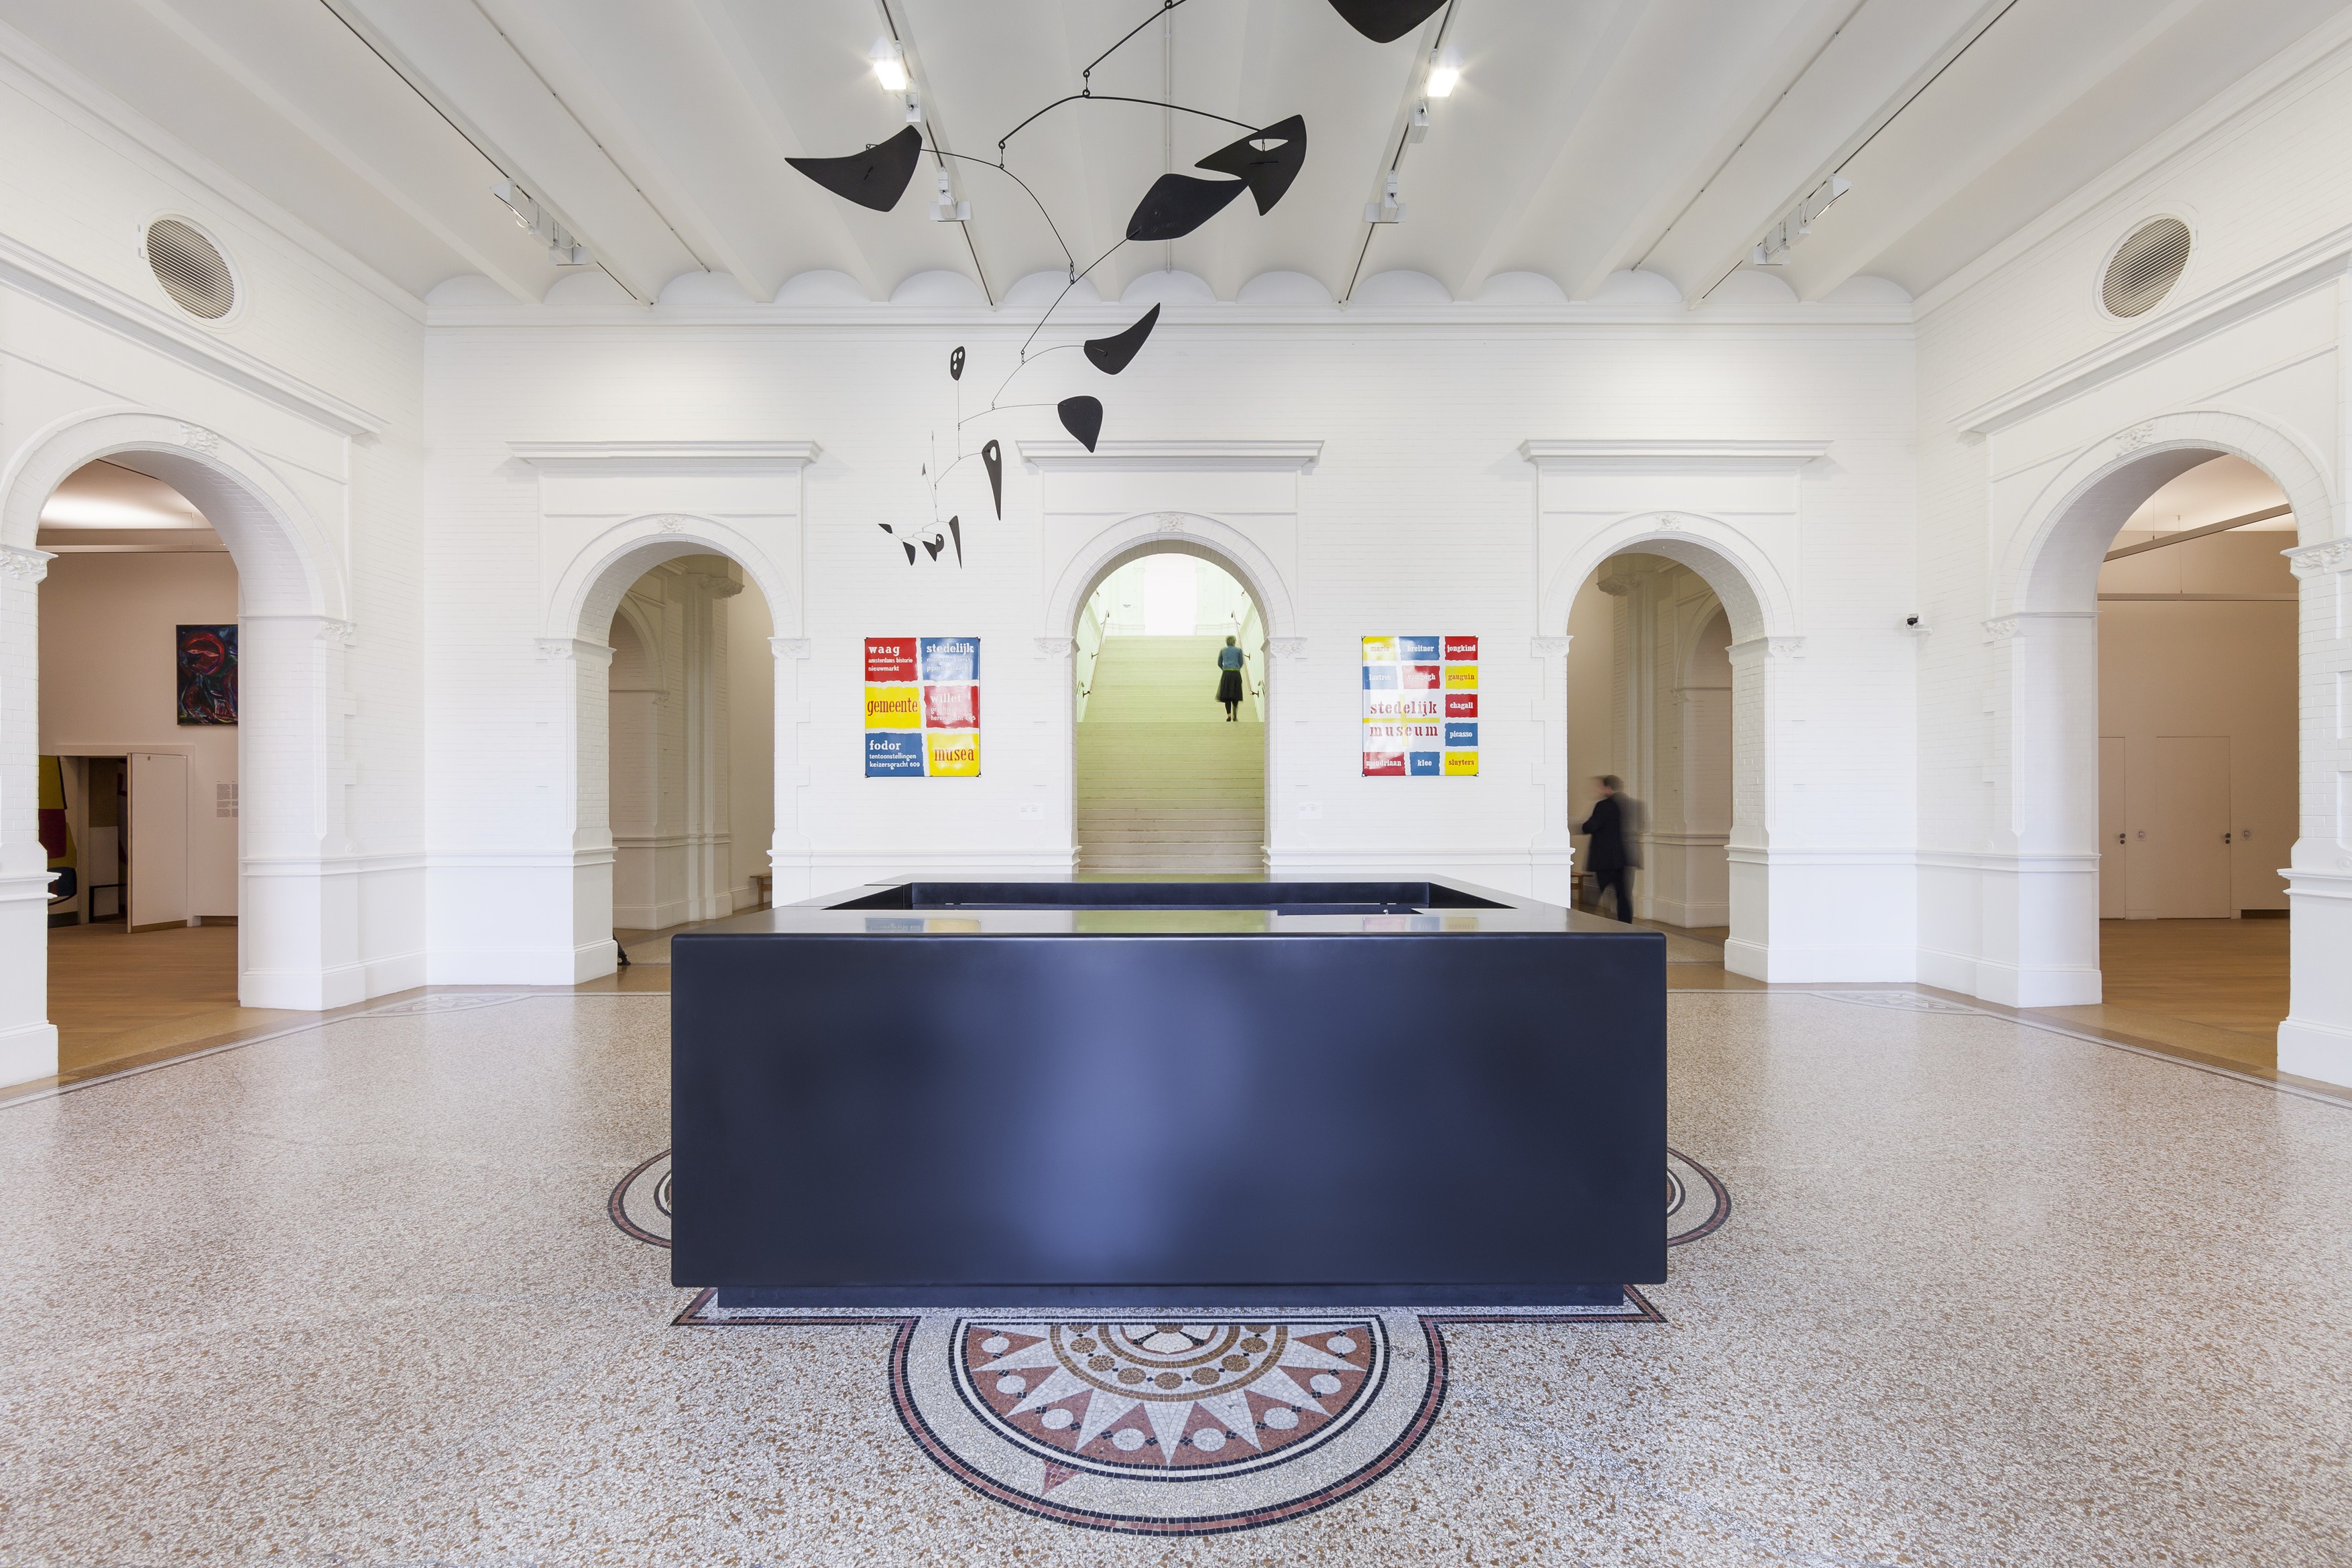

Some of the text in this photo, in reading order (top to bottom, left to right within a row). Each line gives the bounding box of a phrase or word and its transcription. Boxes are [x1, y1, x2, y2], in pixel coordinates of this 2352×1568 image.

[868, 646, 900, 656] waag
[926, 642, 974, 656] stedelijk
[1407, 644, 1435, 652] breitner
[1446, 644, 1476, 653] jongkind
[930, 694, 961, 703] willet
[867, 697, 918, 716] gemeente
[1370, 701, 1437, 717] stedelijk
[1450, 701, 1474, 710] chagall
[1370, 725, 1438, 737] museum
[1449, 731, 1473, 739] picasso
[869, 739, 902, 751] fodor
[869, 752, 917, 761] tentoonstellingen
[934, 748, 975, 762] musea
[870, 762, 908, 770] keizersgracht
[1366, 759, 1402, 767] mondriaan
[1448, 758, 1475, 766] sluyters
